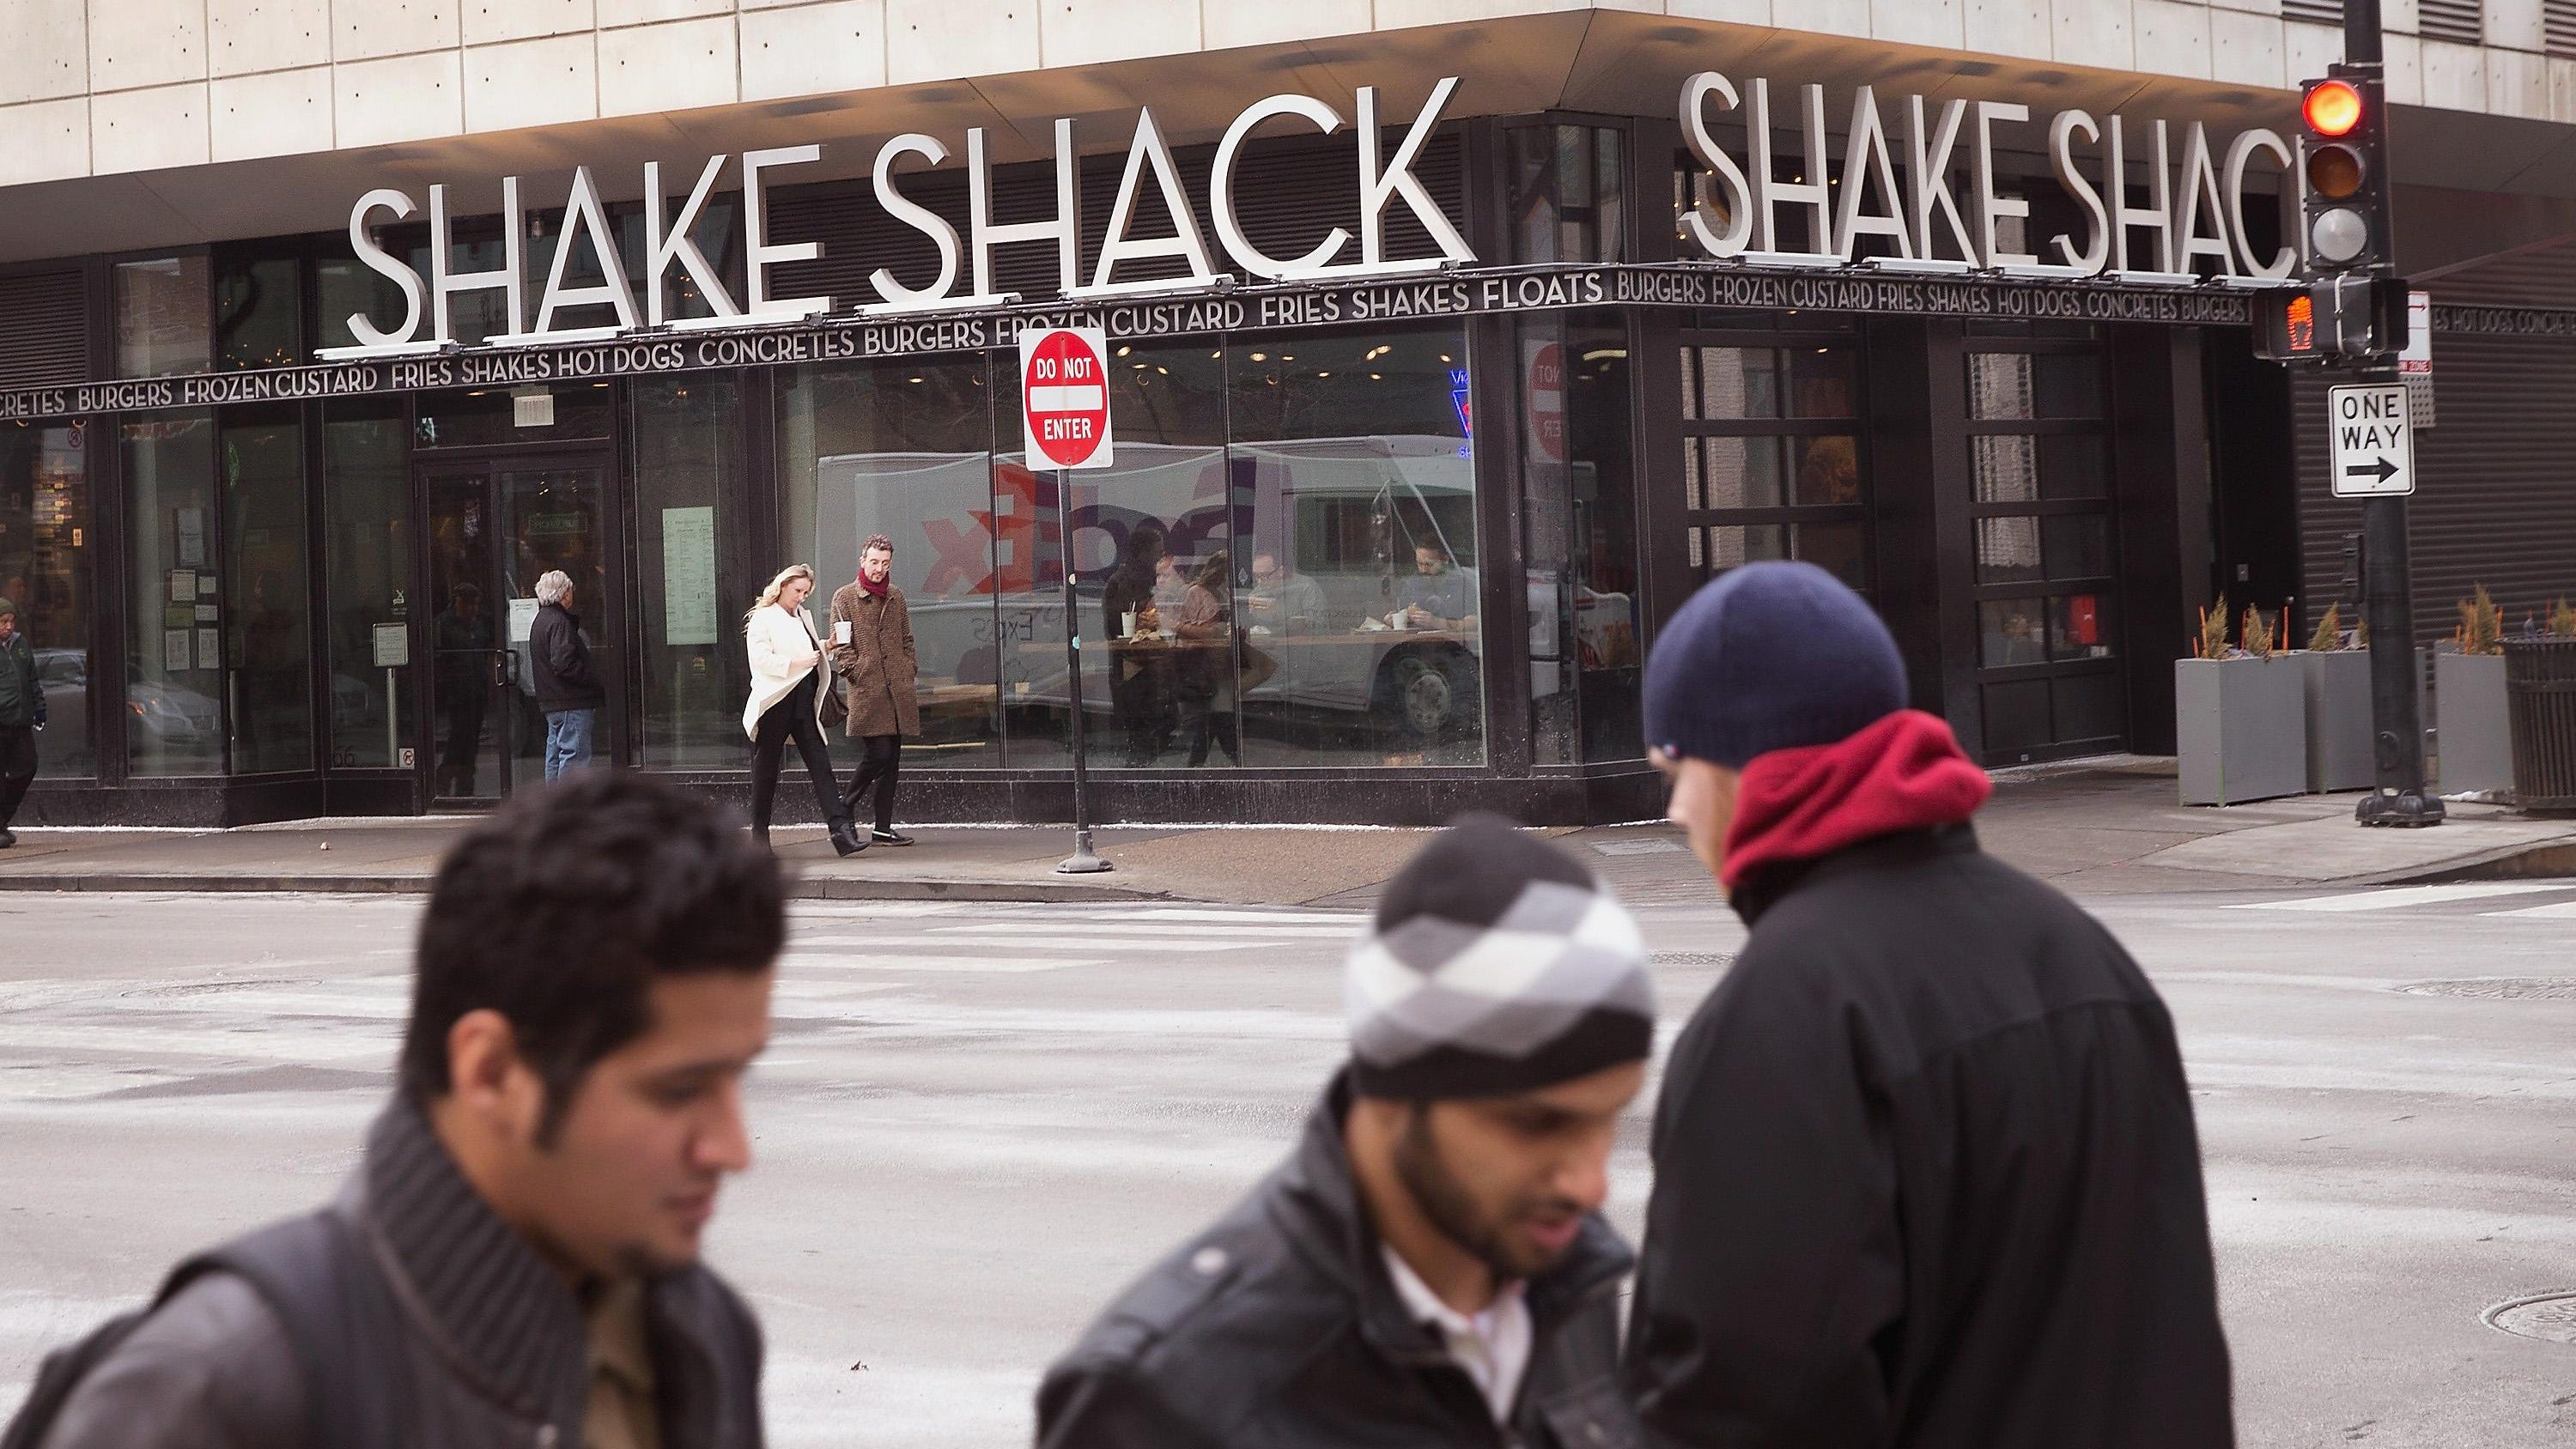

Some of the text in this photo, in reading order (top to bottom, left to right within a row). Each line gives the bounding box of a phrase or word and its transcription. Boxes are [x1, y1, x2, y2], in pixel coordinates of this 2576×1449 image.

[1679, 71, 2038, 268] SHAKE
[346, 76, 1478, 345] SHAKE SHACK
[1618, 271, 1706, 303] BURGERS
[1713, 275, 1787, 306] FROZEN
[1791, 279, 1873, 308] CUSTARD
[1878, 282, 1923, 311] FRIES
[1928, 283, 1990, 312] SHAKES
[1997, 288, 2030, 315] HOT
[2034, 289, 2081, 316] DOGS
[2087, 292, 2177, 320] CONCRETES
[2182, 295, 2245, 323] BURGERS
[0, 389, 65, 417] RETES
[78, 382, 173, 411] BURGERS
[185, 374, 270, 403] FROZEN
[276, 367, 378, 397] CUSTARD
[392, 360, 453, 389] FRIES
[462, 352, 551, 384] SHAKES
[558, 348, 609, 377] HOT
[614, 343, 684, 373] DOGS
[697, 329, 854, 367] CONCRETES
[864, 319, 986, 355] BURGERS
[1111, 300, 1244, 336] CUSTARD
[1261, 292, 1340, 325] FRIES
[1352, 282, 1470, 318] SHAKES
[1483, 272, 1603, 309] FLOATS
[1036, 357, 1092, 379] DO NOT
[2342, 393, 2401, 420] ONE
[1043, 417, 1092, 440] ENTER
[2342, 424, 2403, 451] WAY
